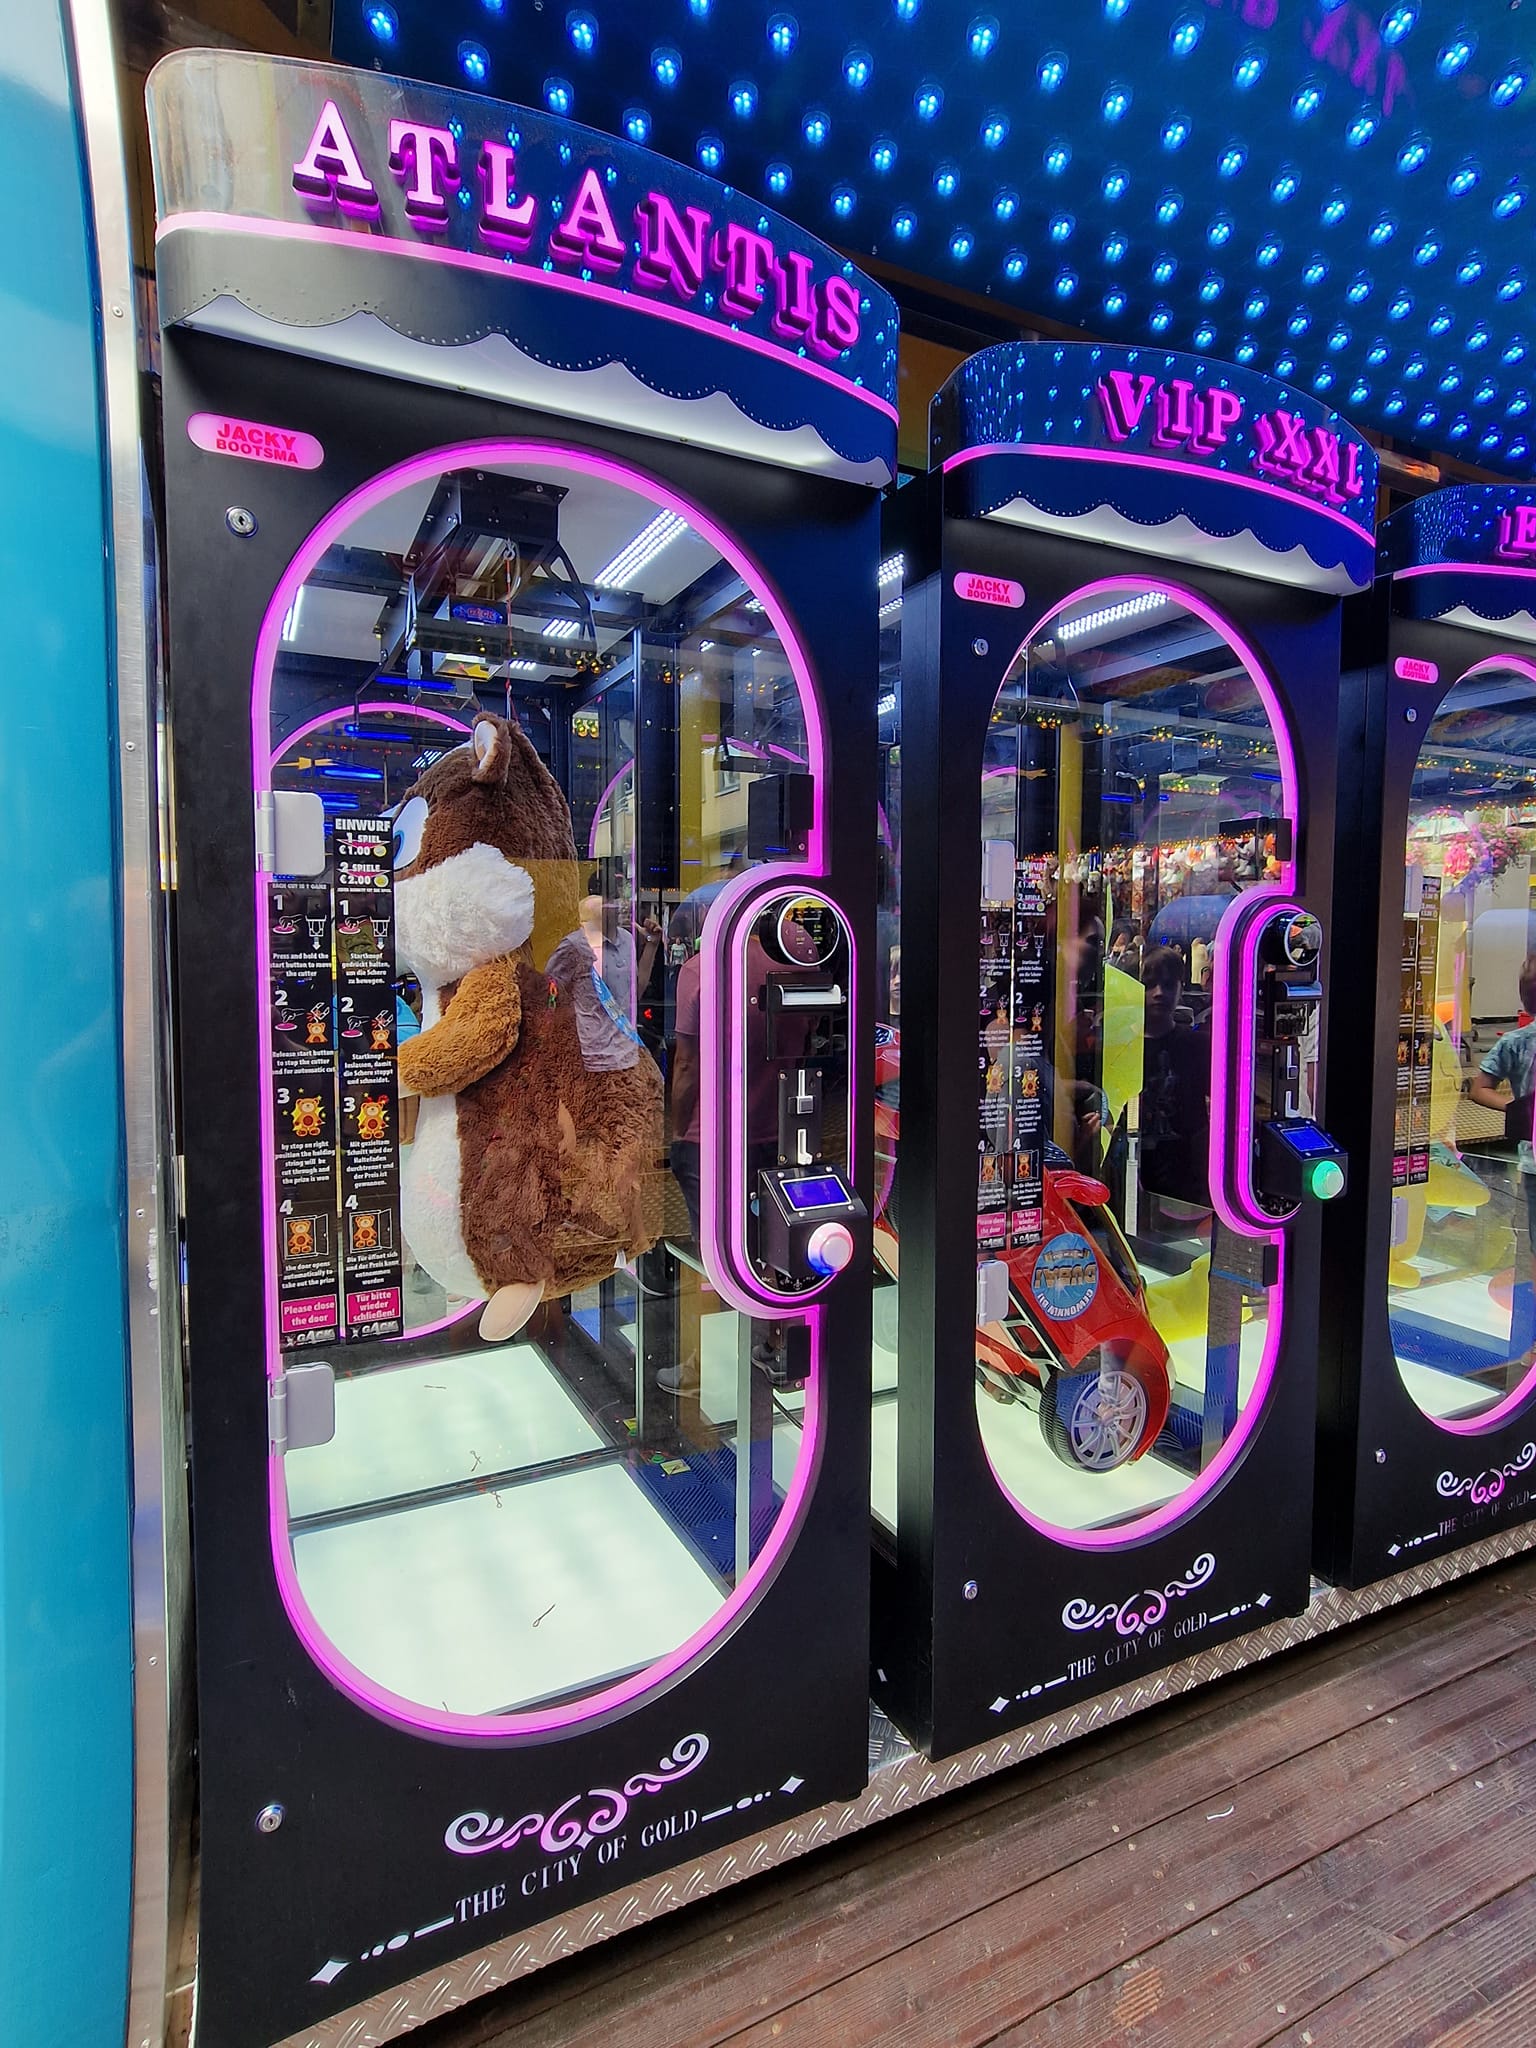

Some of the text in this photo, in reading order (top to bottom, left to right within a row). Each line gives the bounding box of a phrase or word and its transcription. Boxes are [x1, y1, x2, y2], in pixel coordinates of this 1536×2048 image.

[290, 99, 862, 357] ATLANTIS
[217, 423, 296, 450] JACKY
[1098, 370, 1364, 503] VIP XXL
[216, 438, 298, 463] BOOTSMA
[968, 578, 1010, 595] JACKY
[967, 589, 1011, 604] BOOTSMA
[1403, 660, 1430, 673] JACKY
[335, 818, 391, 832] EINWURF
[346, 832, 381, 843] 1 SPIEL
[339, 845, 370, 855] €1.00
[340, 862, 380, 872] 2 SPIELE
[340, 874, 370, 884] €2.00
[274, 895, 283, 910] 1
[340, 900, 349, 915] 1
[981, 915, 987, 928] 1
[1017, 921, 1023, 932] 1
[275, 990, 288, 1006] 2
[980, 986, 987, 997] 2
[1016, 992, 1023, 1004] 2
[341, 997, 354, 1012] 2
[978, 1057, 986, 1069] 3
[1014, 1066, 1022, 1077] 3
[277, 1088, 290, 1104] 3
[344, 1097, 356, 1112] 3
[978, 1140, 985, 1152] 4
[1013, 1139, 1021, 1150] 4
[280, 1200, 293, 1215] 4
[345, 1194, 358, 1210] 4
[1034, 1262, 1098, 1289] DUBAI
[356, 1291, 391, 1303] Tür bitte
[1048, 1288, 1094, 1317] GEWONNEN
[284, 1301, 334, 1315] Please close
[360, 1301, 388, 1311] wieder
[292, 1314, 328, 1326] the door
[353, 1308, 395, 1322] schließen!
[1438, 1518, 1457, 1536] THE
[1067, 1612, 1207, 1681] THE CITY OF GOLD
[455, 1809, 698, 1923] THE CITY OF GOLD
